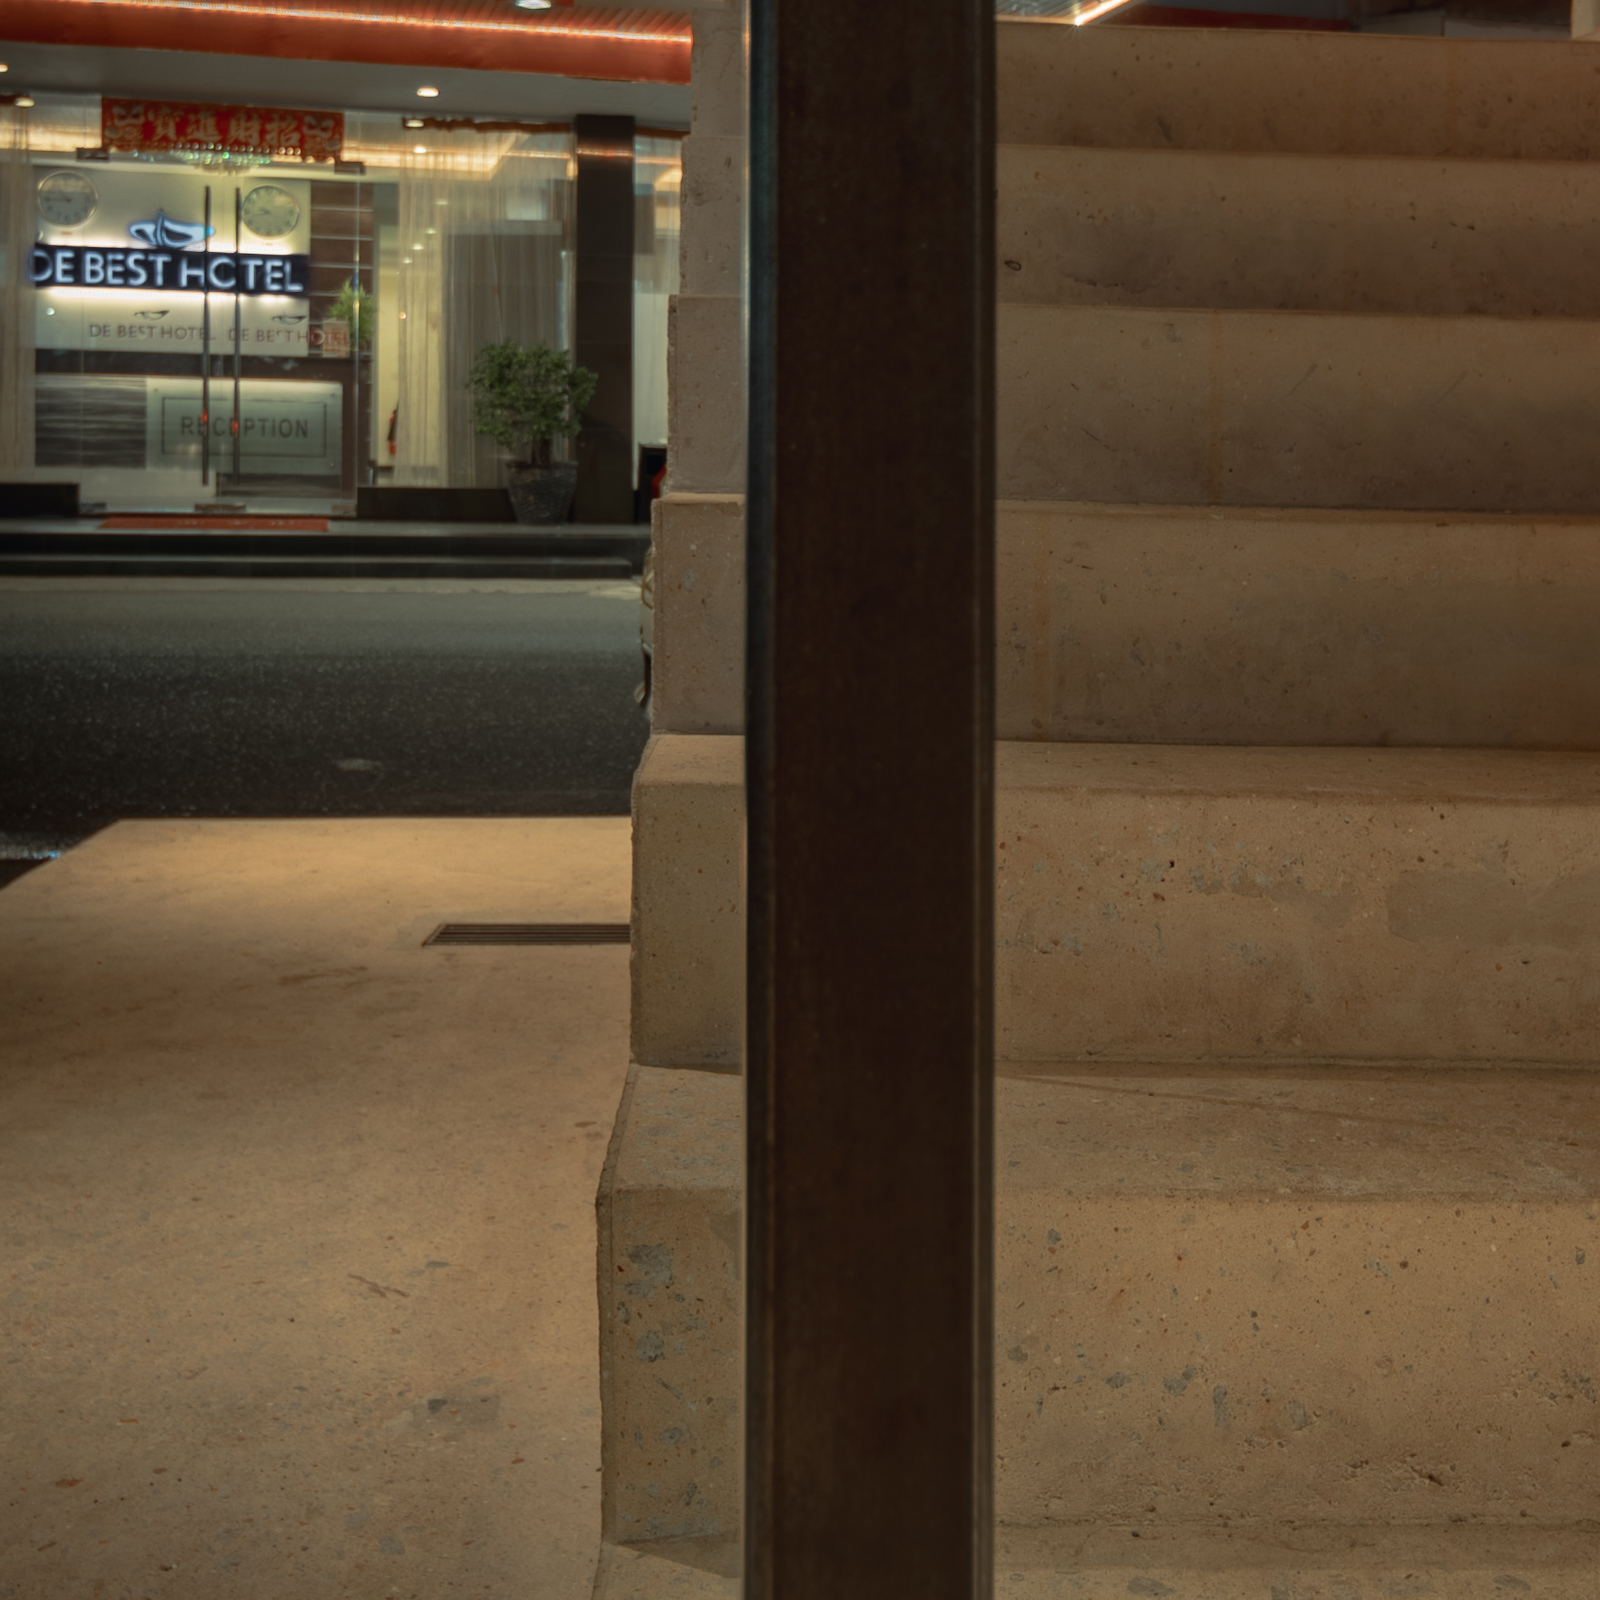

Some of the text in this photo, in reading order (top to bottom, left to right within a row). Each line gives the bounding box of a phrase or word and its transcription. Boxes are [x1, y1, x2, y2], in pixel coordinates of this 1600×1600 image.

[28, 250, 304, 293] DE BEST HOTEL
[89, 324, 111, 338] DE
[117, 324, 157, 339] BEST
